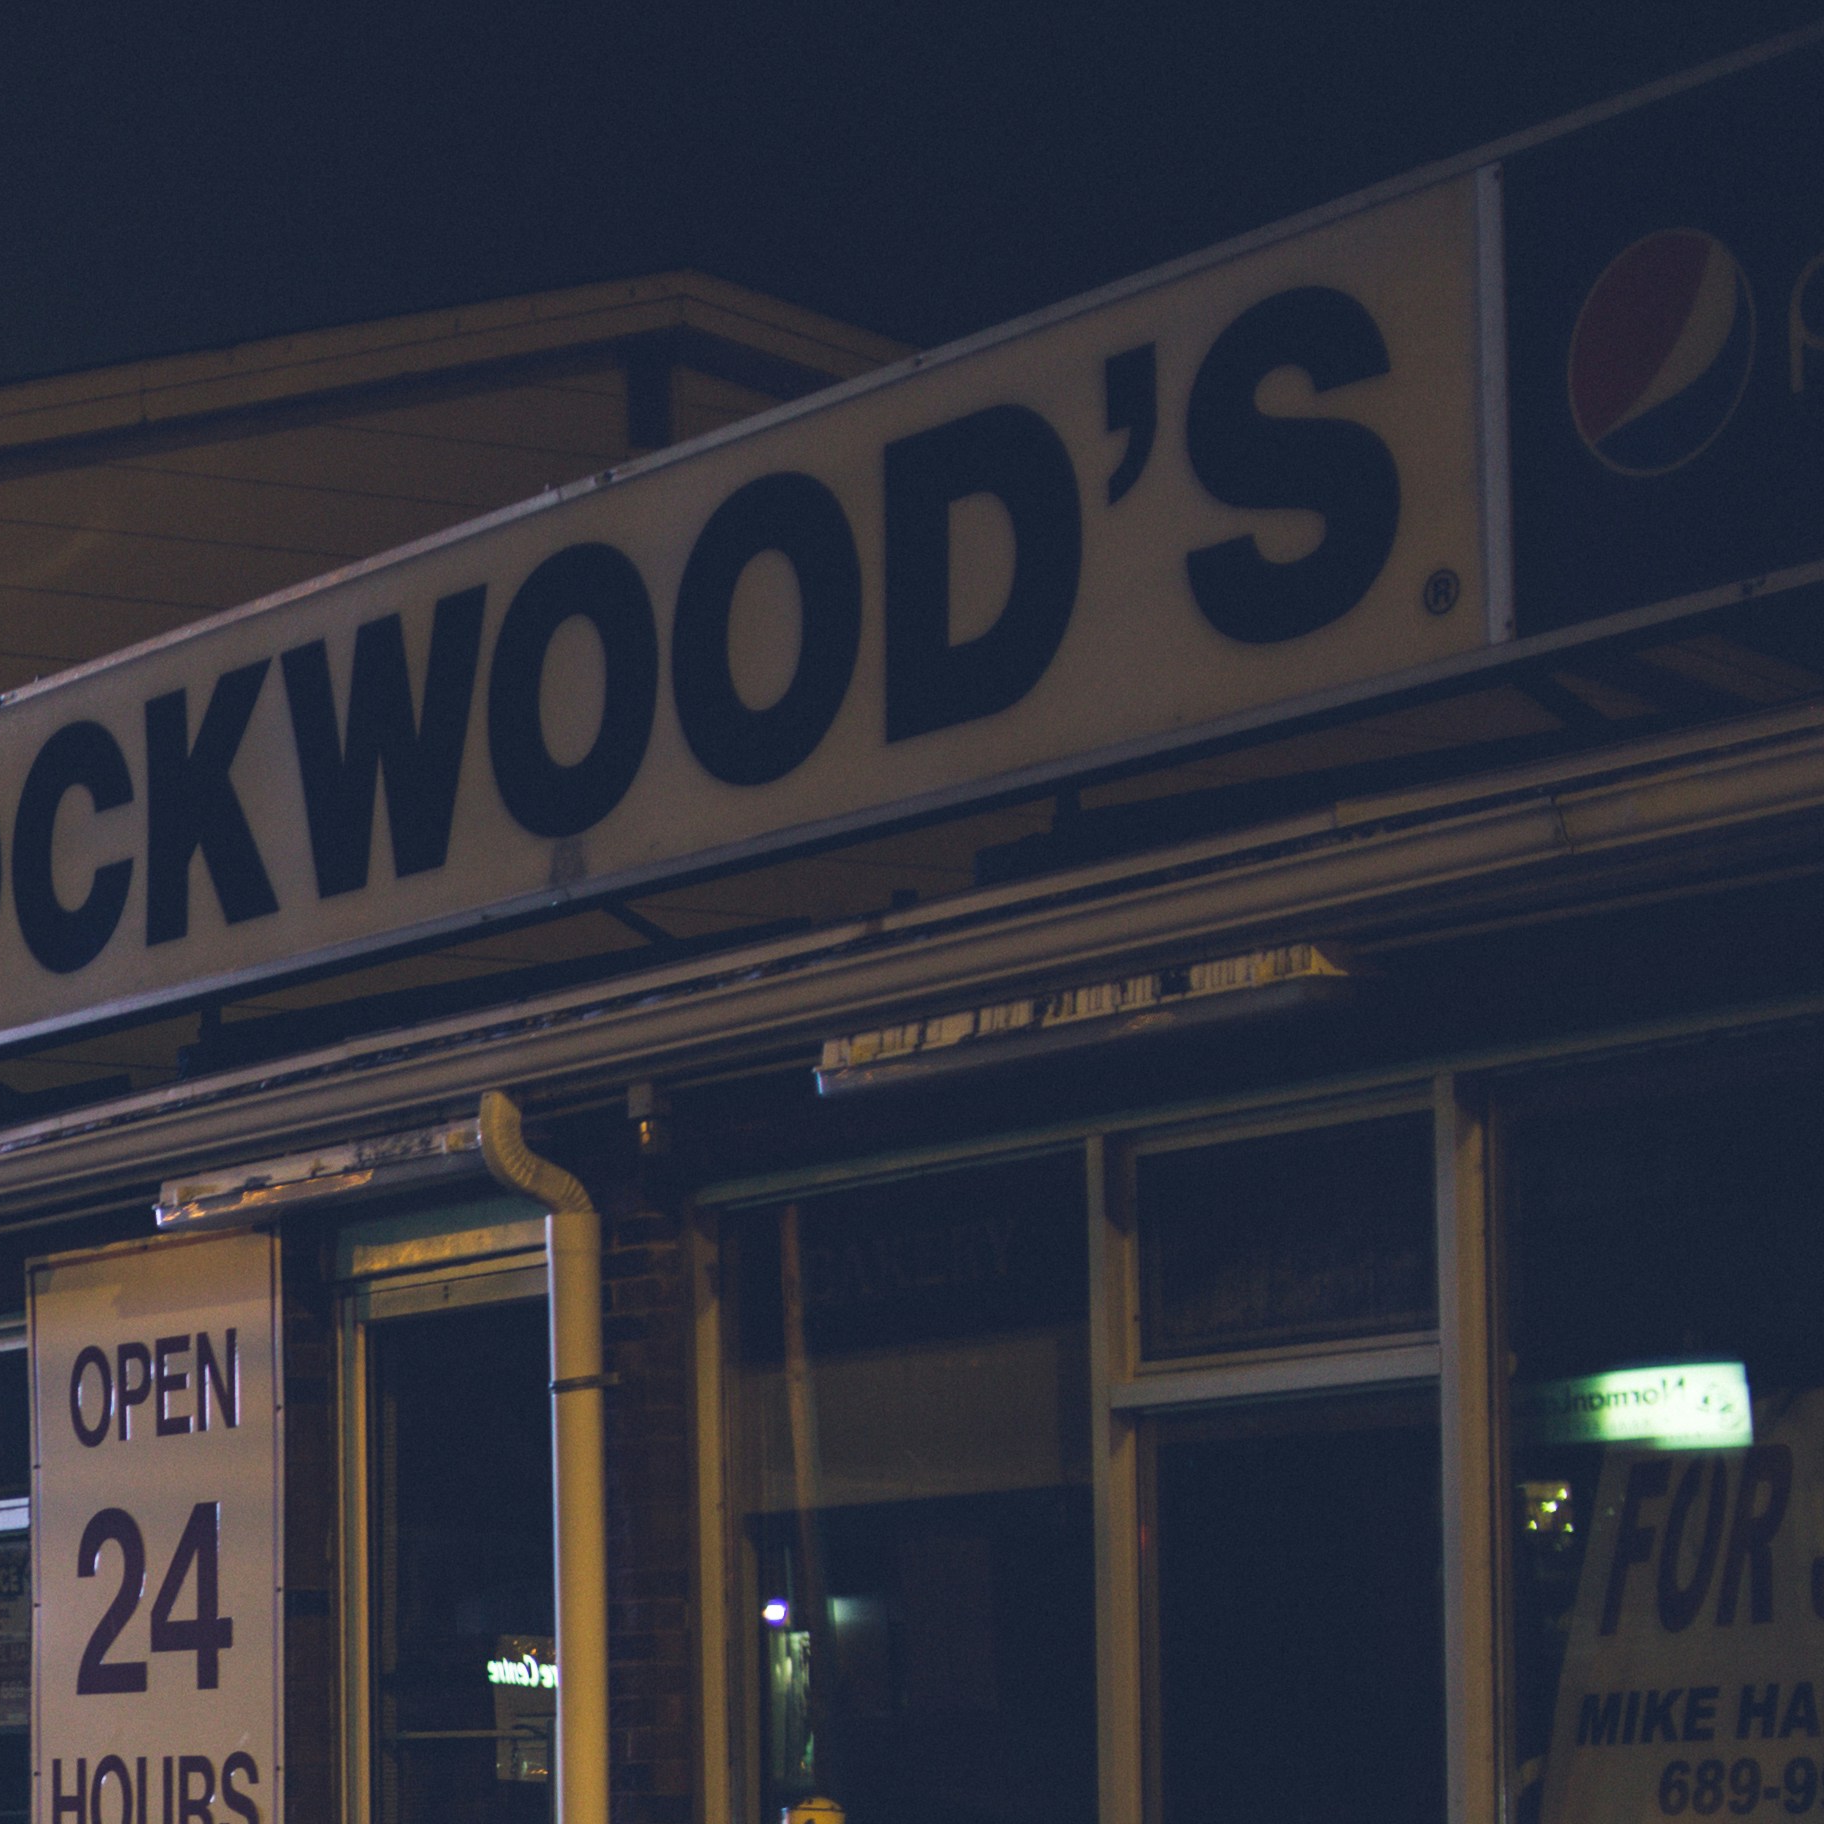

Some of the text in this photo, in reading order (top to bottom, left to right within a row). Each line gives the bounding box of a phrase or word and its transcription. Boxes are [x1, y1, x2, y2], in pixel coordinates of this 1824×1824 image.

[70, 1328, 240, 1448] OPEN
[76, 1501, 233, 1696] 24
[1600, 1444, 1793, 1637] FOR
[1576, 1684, 1721, 1747] MIKE
[1658, 1756, 1824, 1817] 689-9
